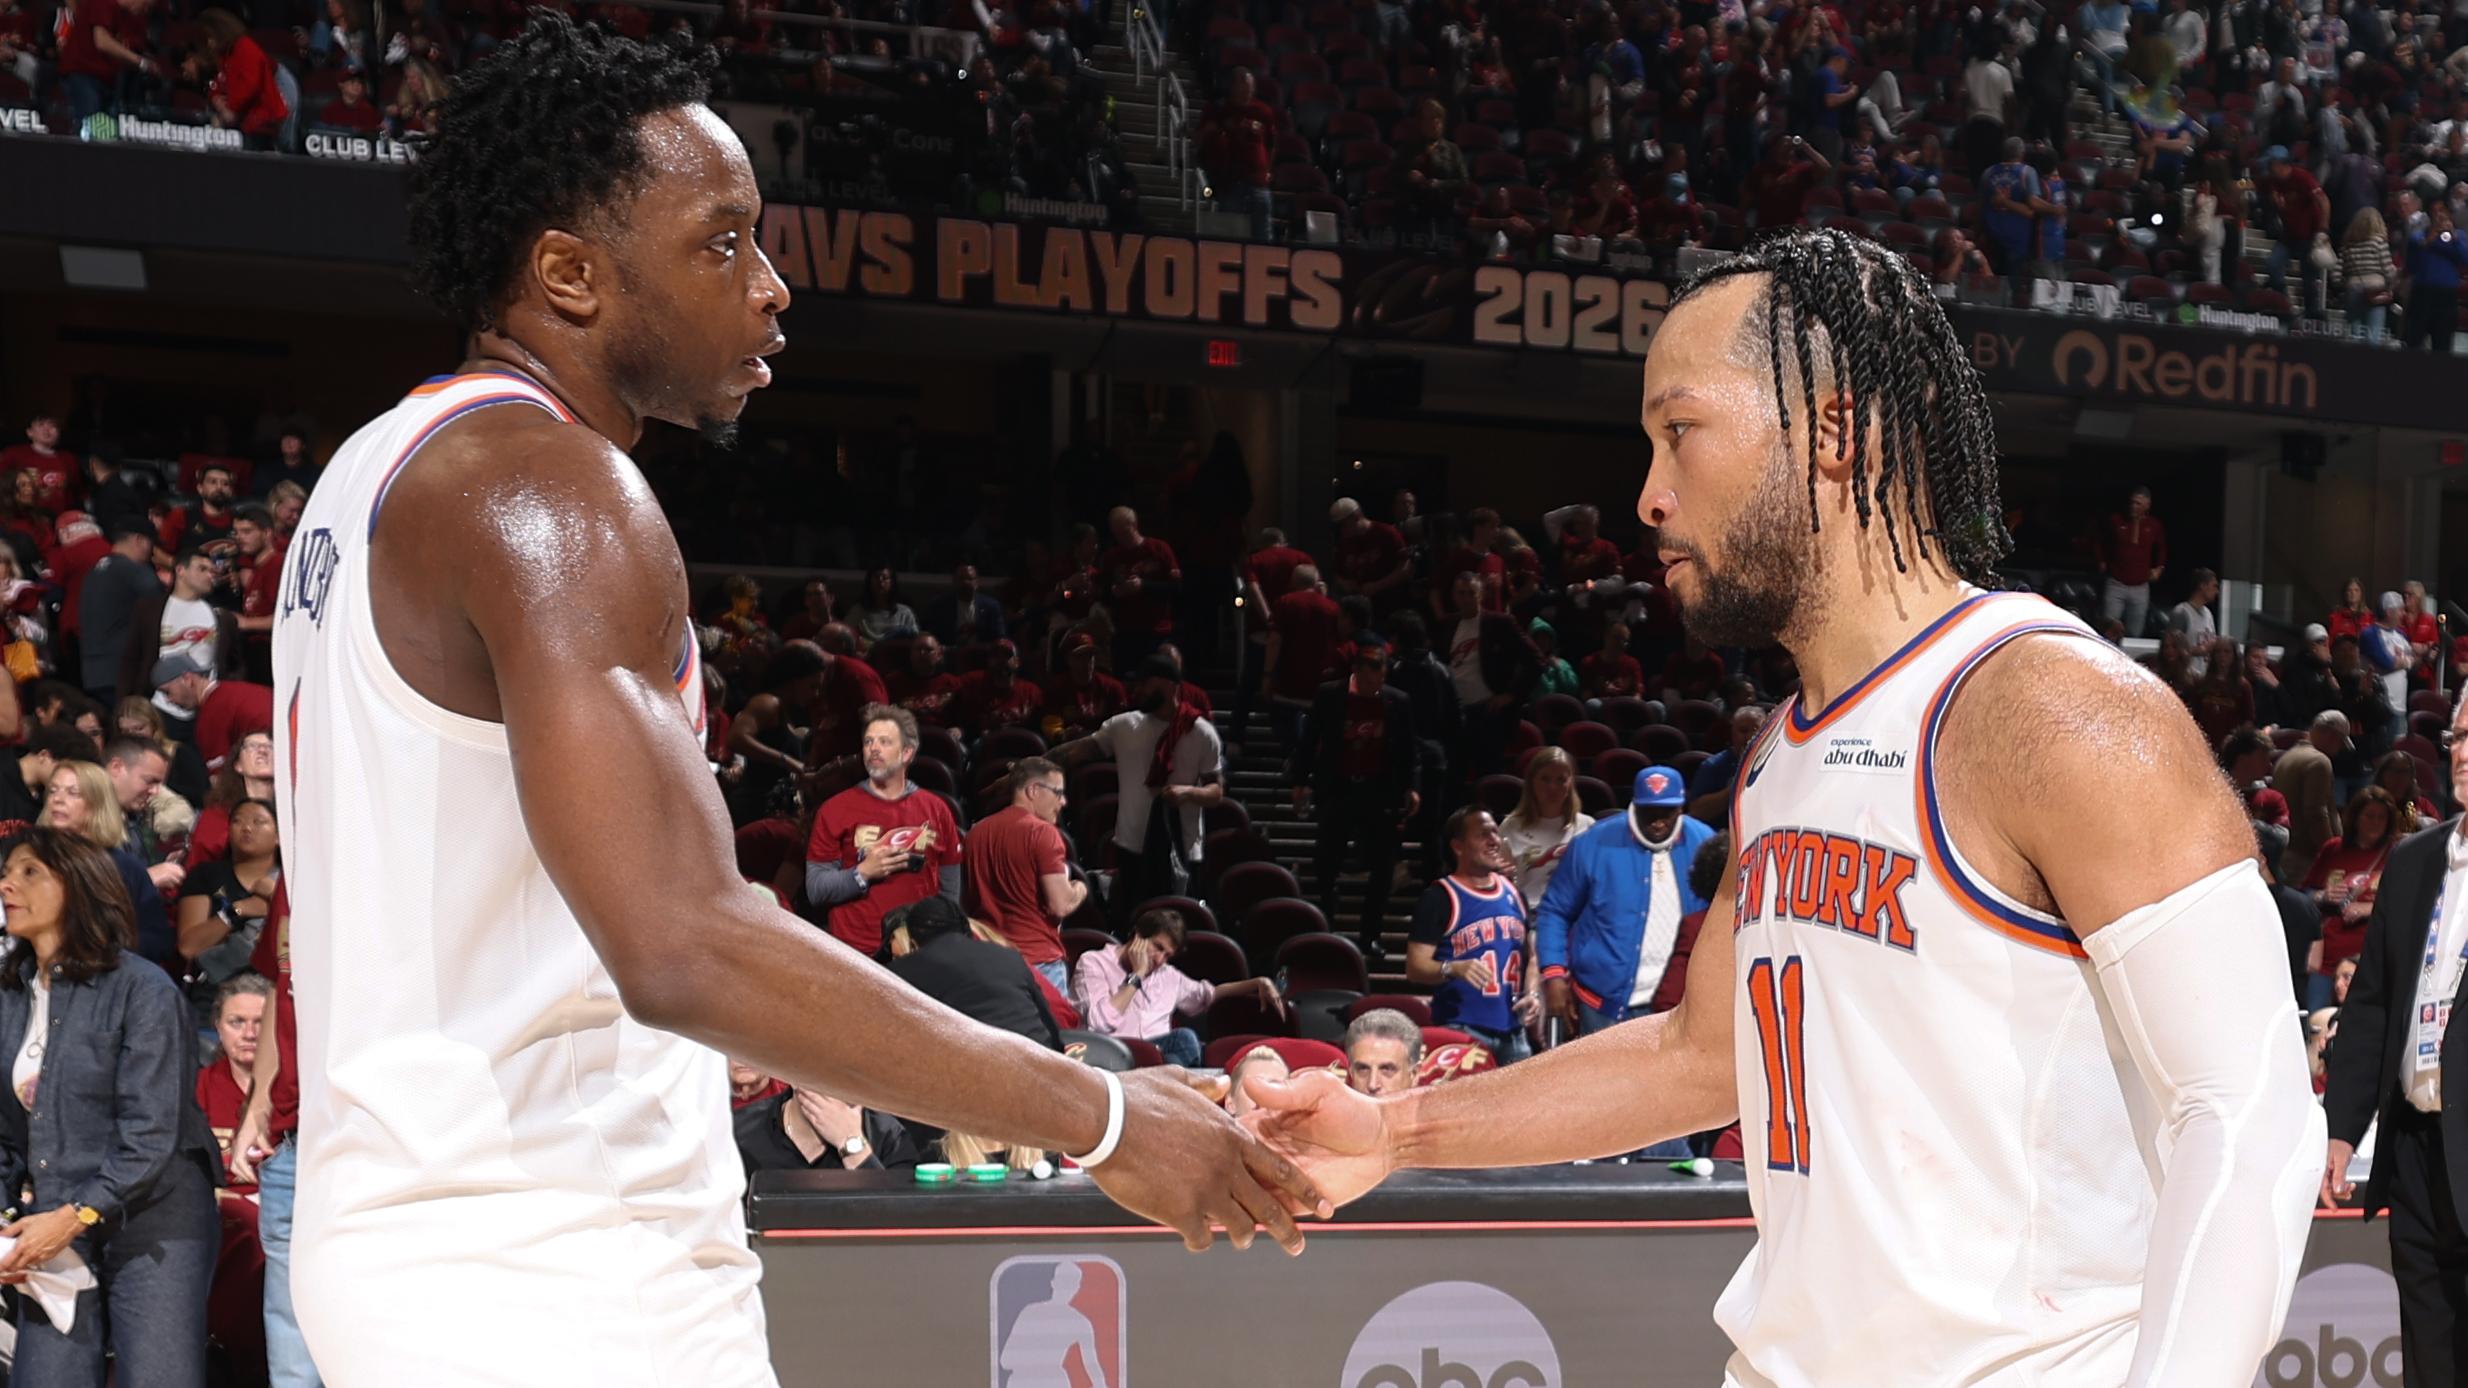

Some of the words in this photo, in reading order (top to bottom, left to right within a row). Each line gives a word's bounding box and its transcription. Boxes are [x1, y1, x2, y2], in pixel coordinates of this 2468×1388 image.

[118, 114, 243, 154] Huntington
[305, 133, 372, 161] CLUB
[760, 201, 914, 298] AVS
[936, 215, 1343, 331] PLAYOFFS
[1473, 265, 1670, 356] 2026
[2198, 304, 2280, 335] Huntington
[2302, 318, 2344, 338] CLUB
[1972, 332, 2028, 370] BY
[2115, 332, 2318, 410] Redfin
[1824, 748, 1855, 766] abu
[1855, 748, 1908, 769] dhabi
[1830, 737, 1872, 747] experience
[1769, 825, 1920, 956] YORK
[1450, 916, 1495, 958] NEW
[1479, 949, 1522, 997] 14
[1747, 954, 1811, 1177] 11
[2265, 1323, 2404, 1388] abc
